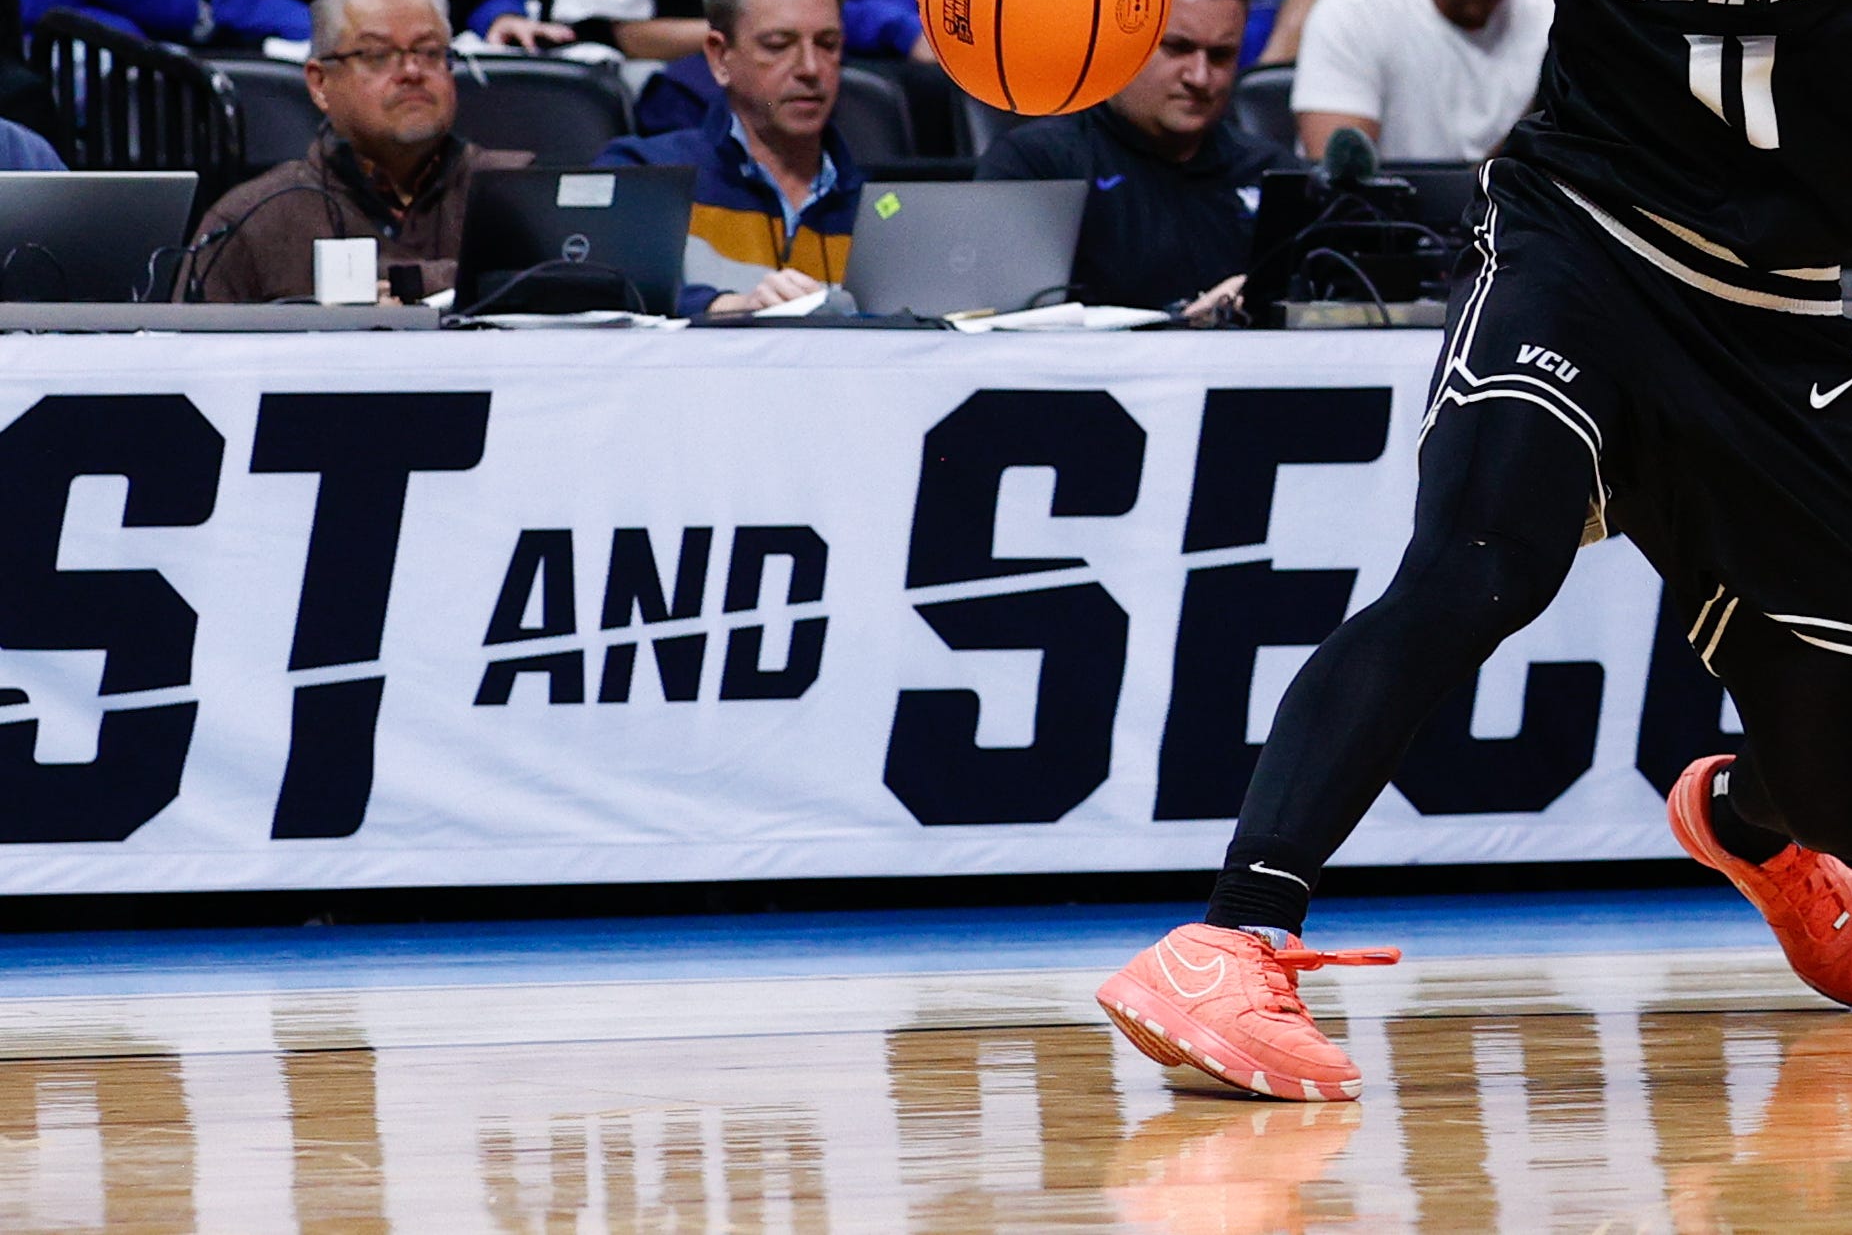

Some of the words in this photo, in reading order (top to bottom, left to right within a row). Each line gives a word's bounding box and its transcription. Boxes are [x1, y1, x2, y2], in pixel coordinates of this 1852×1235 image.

[1682, 34, 1780, 150] 11
[1515, 344, 1581, 383] VCU
[473, 525, 829, 707] AND
